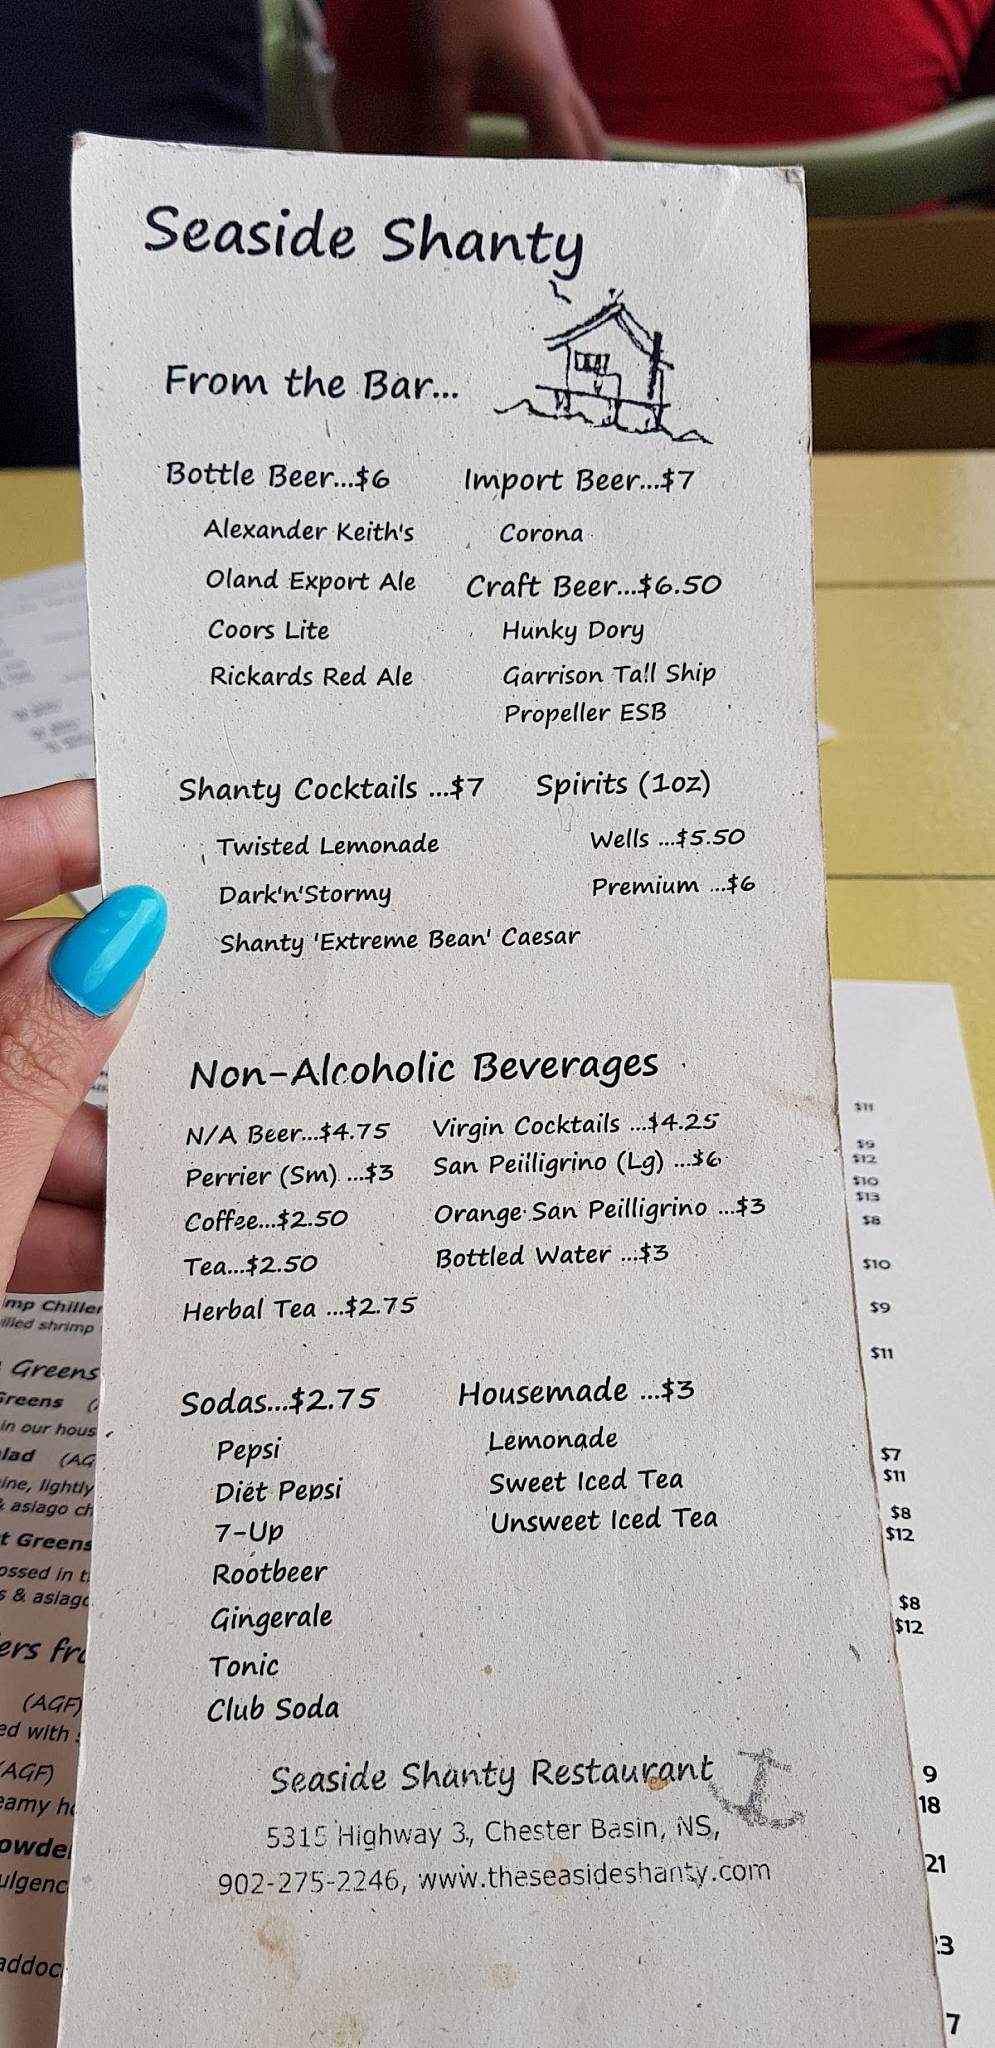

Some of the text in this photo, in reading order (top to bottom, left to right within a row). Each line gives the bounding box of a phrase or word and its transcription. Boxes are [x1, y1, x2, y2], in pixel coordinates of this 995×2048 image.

[144, 204, 584, 282] Seaside Shanty
[165, 363, 269, 396] From
[283, 364, 346, 400] the
[166, 459, 256, 487] Bottle
[464, 467, 565, 501] Import
[202, 516, 415, 543] Alexander Keith's
[499, 522, 584, 544] Corona
[205, 567, 417, 598] Oland Export Ale
[466, 571, 542, 599] Craft
[207, 618, 330, 641] Coors Lite
[502, 618, 645, 647] Hunky Dory
[210, 664, 414, 687] Rickards Red Ale
[502, 661, 717, 688] Garrison Tall Ship
[504, 701, 667, 730] Propeller ESB
[178, 775, 282, 809] Shanty
[294, 773, 418, 801] Cocktails
[536, 768, 711, 805] Spirits (1oz)
[215, 831, 440, 857] Twisted Lemonade
[589, 827, 650, 850] Wells
[219, 883, 392, 909] Dark'n'Stormy
[592, 874, 700, 897] Premium
[220, 926, 582, 959] Shanty 'Extreme Bean' Caesar
[189, 1049, 659, 1090] Non-Alcoholic Beverages
[855, 1102, 873, 1112] $11
[185, 1124, 238, 1147] N/A
[432, 1115, 505, 1144] Virgin
[514, 1111, 621, 1137] Cocktails
[857, 1139, 875, 1149] $9
[433, 1156, 479, 1177] San
[616, 1149, 664, 1177] (Lg)
[853, 1154, 877, 1164] $12
[185, 1164, 273, 1188] Perrier
[279, 1162, 338, 1190] (Sm)
[853, 1176, 878, 1186] $10
[856, 1192, 880, 1201] $13
[434, 1204, 522, 1230] Orange
[532, 1201, 579, 1222] San
[863, 1216, 881, 1225] $8
[435, 1243, 525, 1270] Bottled
[535, 1244, 612, 1266] Water
[863, 1258, 891, 1270] $10
[182, 1297, 265, 1323] Herbal
[272, 1298, 317, 1319] Tea
[870, 1301, 890, 1314] $9
[38, 1320, 95, 1335] shrimp
[871, 1347, 893, 1359] $11
[12, 1359, 100, 1380] Greens
[458, 1375, 629, 1407] Housemade
[1, 1420, 96, 1437] in our hous
[488, 1425, 619, 1452] Lemonade
[216, 1436, 283, 1469] Pepsi
[881, 1447, 901, 1461] $7
[40, 1478, 94, 1497] lightly
[489, 1466, 684, 1495] Sweet Iced Tea
[884, 1469, 905, 1482] $11
[278, 1476, 344, 1503] Pepsi
[11, 1500, 68, 1517] asiago
[491, 1505, 719, 1535] Unsweet Iced Tea
[891, 1505, 911, 1520] $8
[17, 1533, 92, 1551] Greens
[214, 1520, 284, 1546] 7-Up
[886, 1526, 914, 1542] $12
[56, 1567, 73, 1582] in
[212, 1557, 329, 1586] Rootbeer
[13, 1588, 26, 1602] &
[899, 1594, 921, 1610] $8
[210, 1601, 333, 1638] Gingerale
[896, 1617, 924, 1634] $12
[208, 1651, 279, 1678] Tonic
[23, 1692, 82, 1717] (AGF)
[206, 1692, 340, 1723] Club Soda
[28, 1724, 69, 1743] with
[270, 1754, 714, 1798] Seaside Shanty Restaurant
[923, 1765, 937, 1783] 9
[919, 1796, 941, 1814] 18
[267, 1826, 327, 1848] 5315
[338, 1823, 441, 1851] Highway
[485, 1819, 582, 1842] Chester
[592, 1816, 666, 1843] Basin,
[677, 1815, 720, 1840] NS,
[925, 1854, 946, 1873] 21
[219, 1862, 771, 1895] 902-275-2246, www.theseasideshanty.com
[936, 1935, 954, 1955] 3
